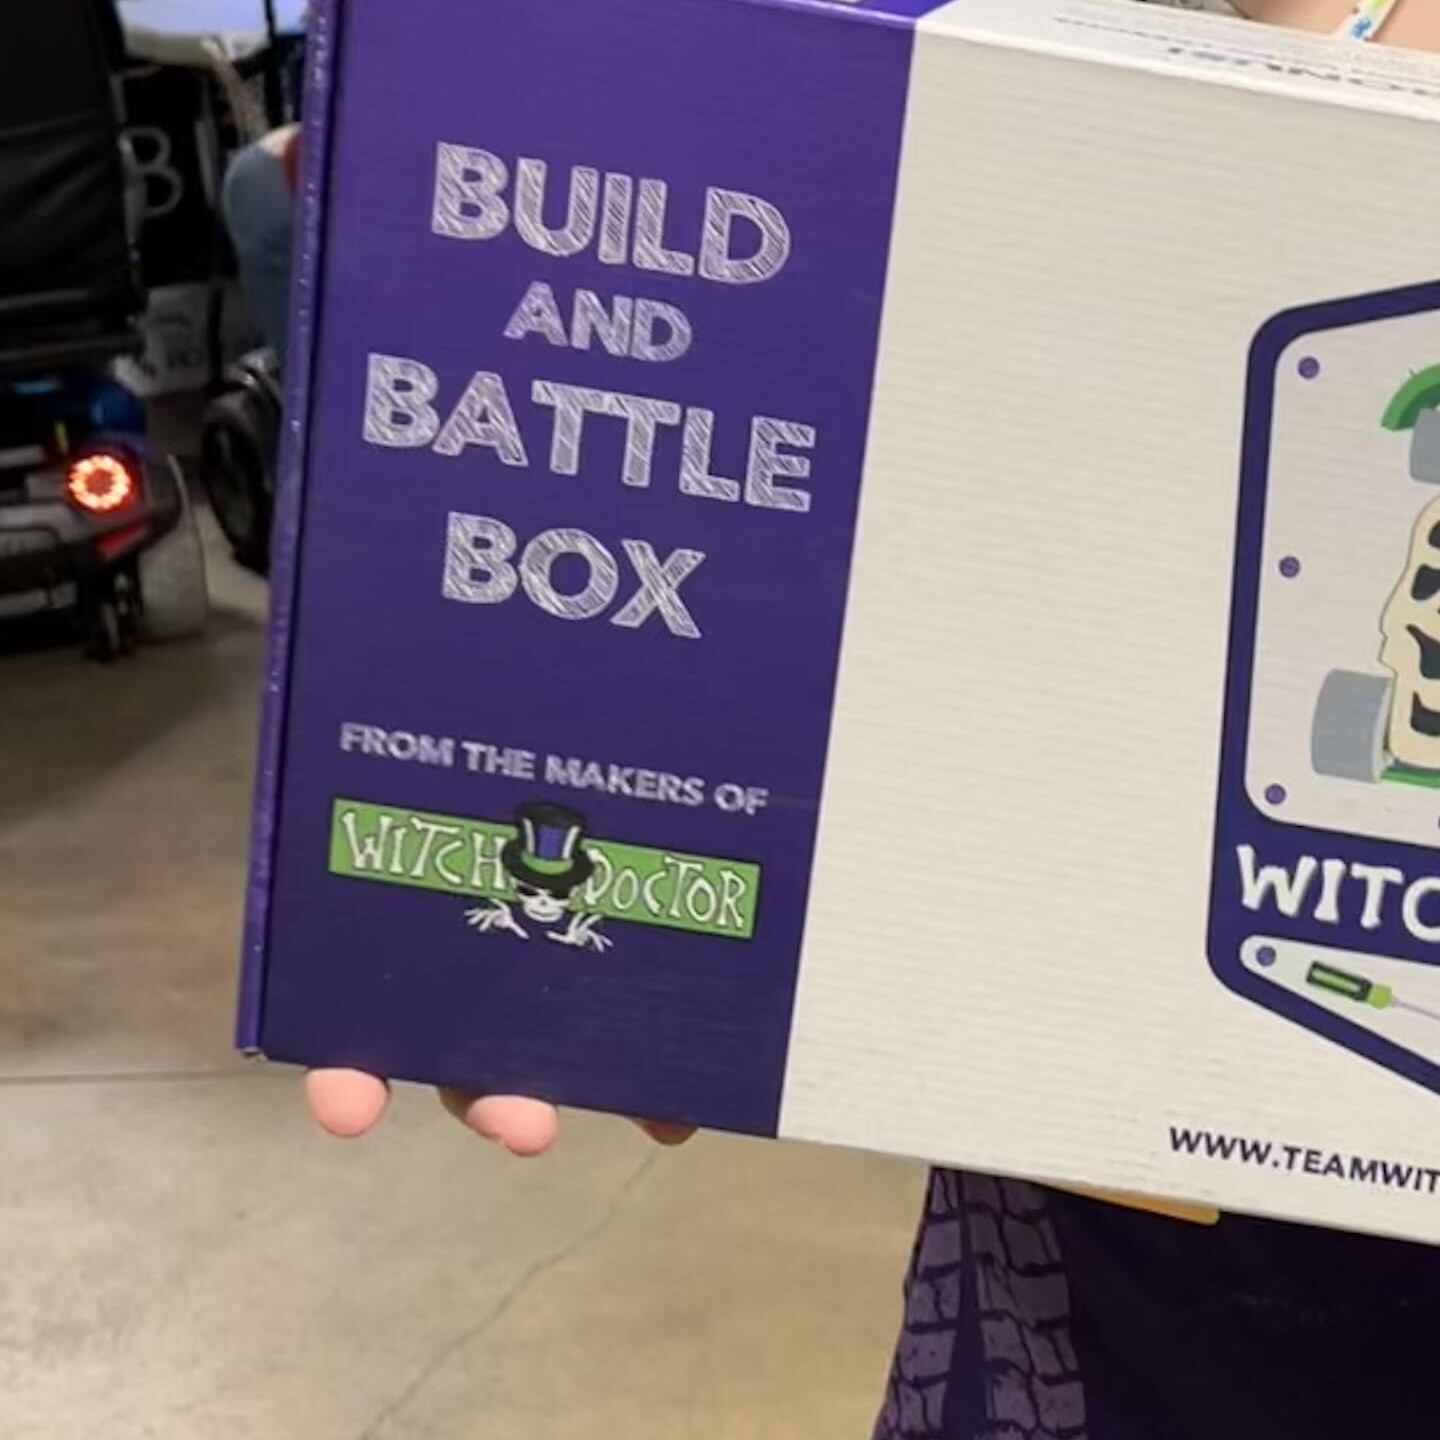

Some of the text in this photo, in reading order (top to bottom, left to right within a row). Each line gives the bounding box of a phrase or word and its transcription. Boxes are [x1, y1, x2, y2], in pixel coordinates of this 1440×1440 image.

[431, 141, 791, 284] BUILD
[503, 281, 693, 361] AND
[363, 352, 816, 512] BATTLE
[442, 511, 706, 638] BOX
[340, 722, 769, 816] FROM THE MAKERS OF
[341, 811, 747, 929] WITCH DOCTOR
